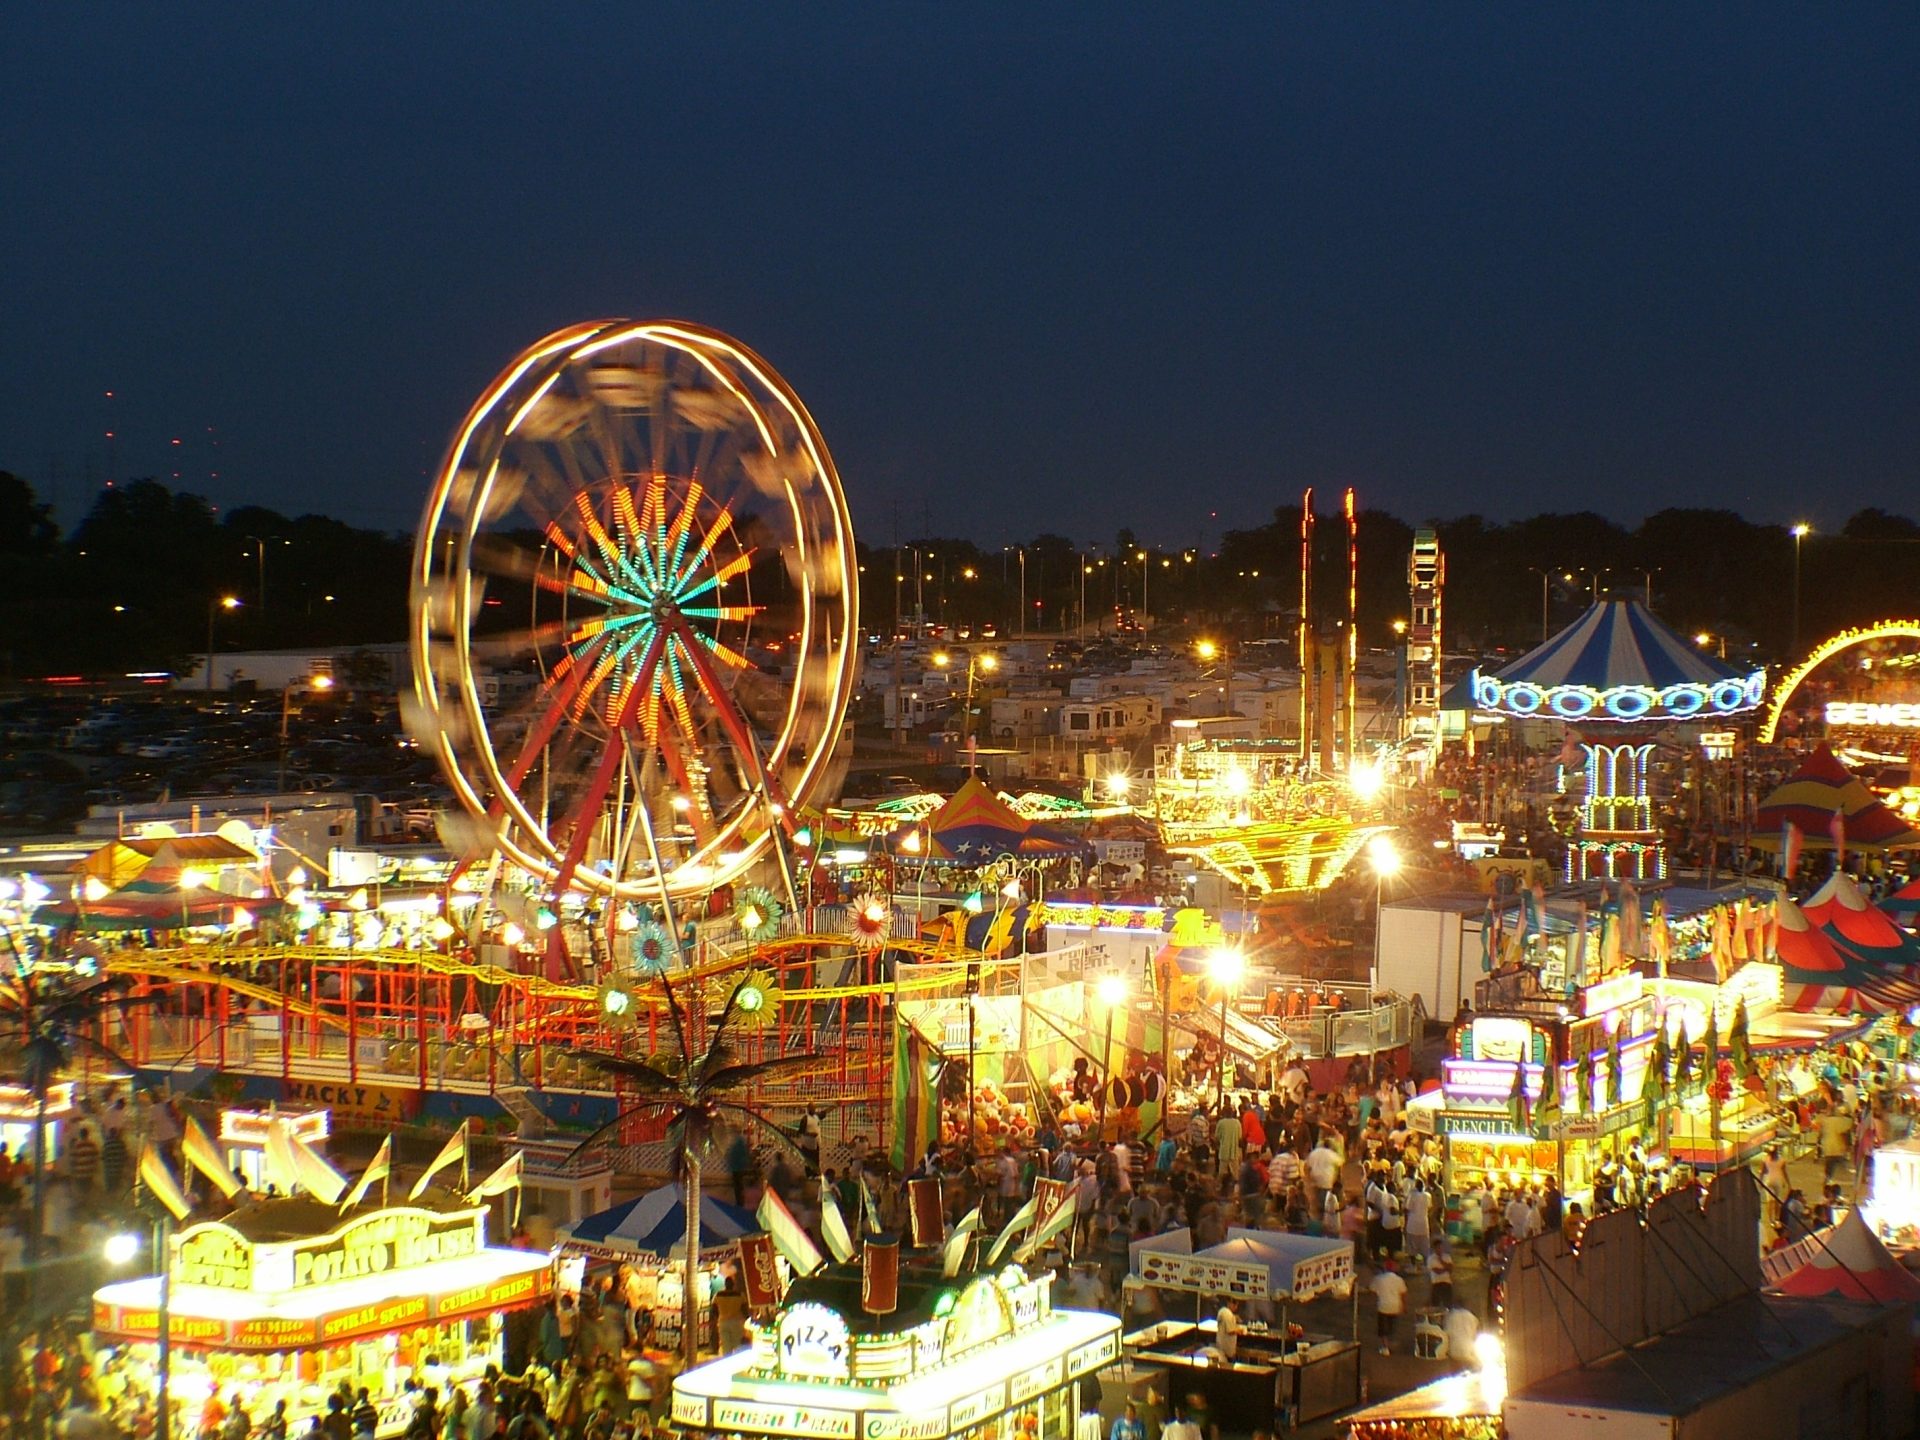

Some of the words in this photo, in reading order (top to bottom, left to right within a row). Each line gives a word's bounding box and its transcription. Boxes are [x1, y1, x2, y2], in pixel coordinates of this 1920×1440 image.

[286, 1083, 367, 1106] WACKY
[1443, 1117, 1496, 1134] FRENCH
[1500, 1120, 1540, 1137] FRES
[294, 1243, 388, 1288] POTATO
[394, 1227, 474, 1268] HOUSE
[439, 1285, 490, 1313] CURLY
[491, 1275, 534, 1303] FRIES
[244, 1319, 305, 1334] JUMBO
[324, 1306, 378, 1336] SPIRAL
[379, 1298, 425, 1325] SPUDS
[783, 1325, 842, 1360] PIZZA
[900, 1415, 947, 1439] DRINKS
